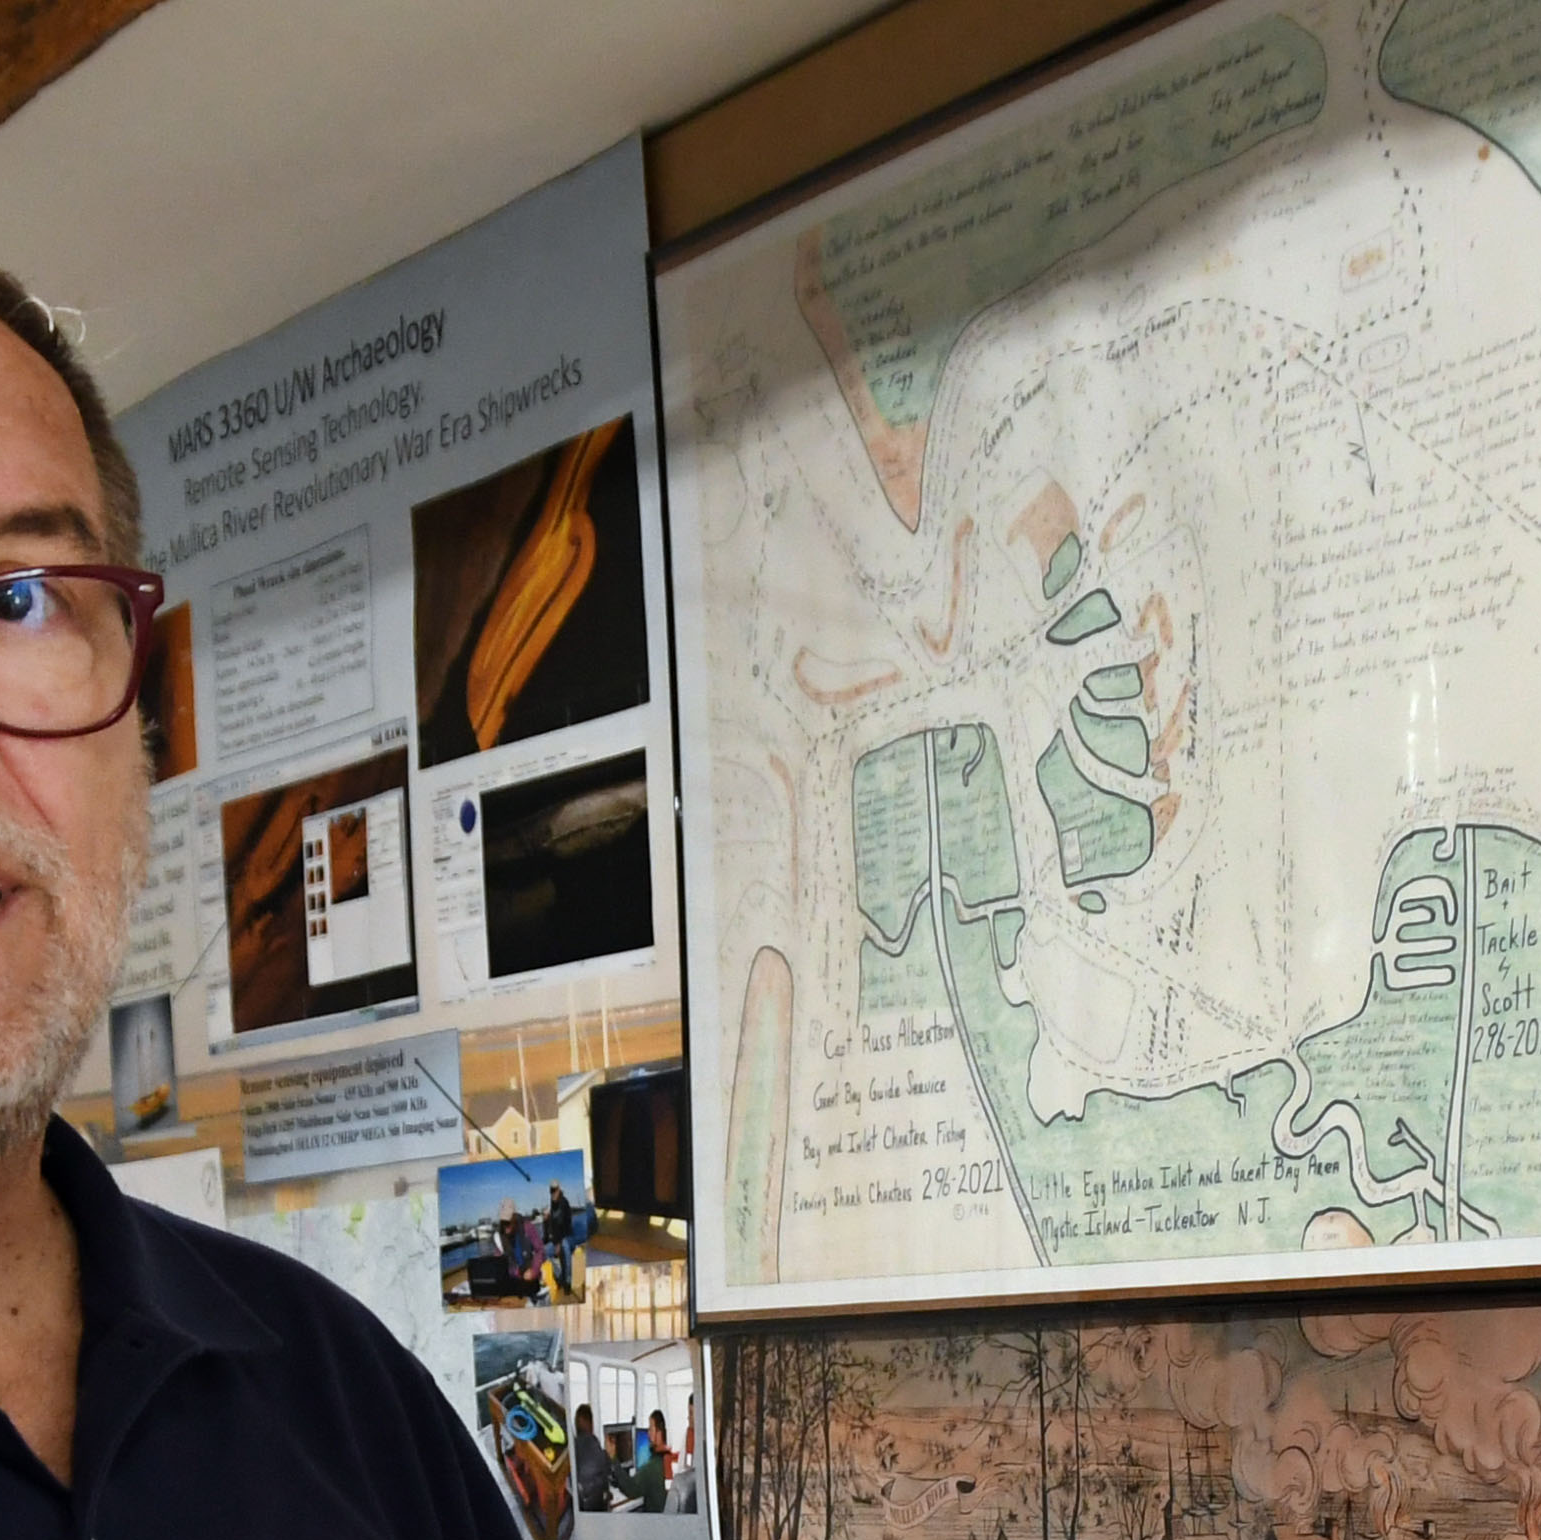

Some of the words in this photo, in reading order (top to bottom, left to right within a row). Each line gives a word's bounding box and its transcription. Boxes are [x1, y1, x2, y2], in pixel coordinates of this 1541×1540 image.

[168, 411, 214, 464] MARS
[218, 387, 269, 441] 3360
[274, 364, 316, 416] U/W
[322, 308, 446, 394] Archaeology
[169, 523, 218, 571] Mullica
[221, 499, 268, 543] River
[273, 446, 389, 523] Revolutionary
[394, 427, 433, 467] War
[439, 412, 473, 449] Era
[478, 352, 583, 434] Shipwrecks
[184, 460, 246, 507] Remote
[251, 427, 319, 480] Sensing
[1483, 860, 1532, 899] Bait
[1476, 913, 1538, 955] Tackle
[1482, 972, 1535, 1017] Scott
[861, 1023, 892, 1053] Russ
[897, 1011, 956, 1048] Albertson
[868, 1076, 901, 1102] Guide
[1030, 1174, 1073, 1201] Little
[1083, 1169, 1106, 1209] Egg
[1159, 1166, 1194, 1190] Inlet
